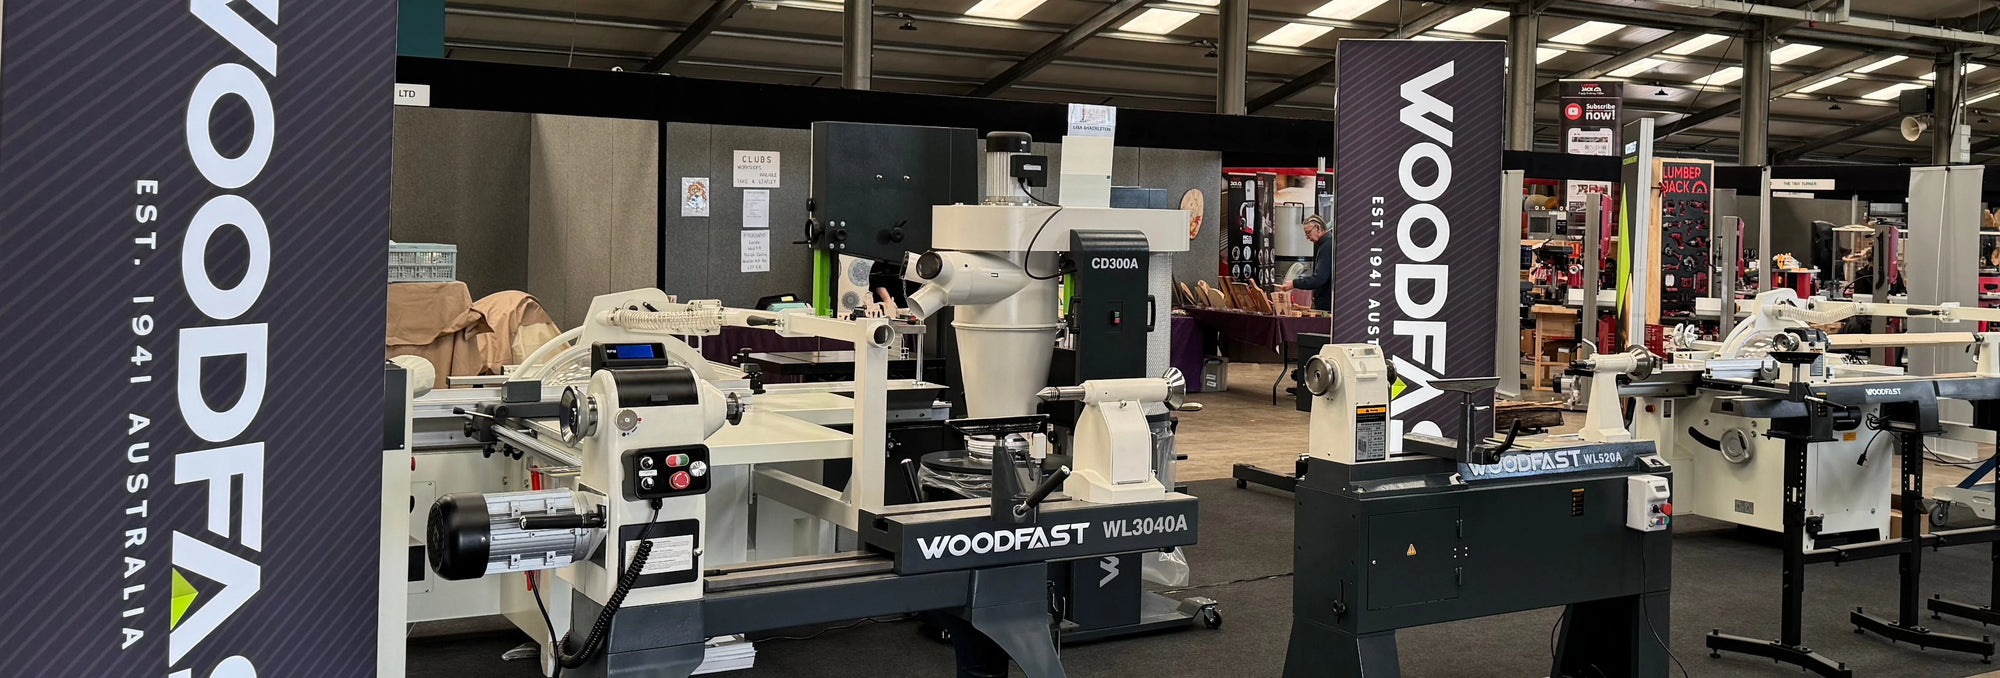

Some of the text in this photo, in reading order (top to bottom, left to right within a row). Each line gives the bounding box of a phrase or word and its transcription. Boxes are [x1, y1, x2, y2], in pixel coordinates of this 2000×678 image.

[398, 89, 416, 98] LTD
[1585, 110, 1616, 120] now!
[742, 155, 772, 163] CLUBS
[1663, 166, 1702, 179] LUMBER
[1664, 180, 1690, 193] JACK
[1371, 196, 1385, 236] EST.
[1091, 257, 1139, 269] CD300A
[1369, 248, 1383, 287] 1941
[1864, 387, 1902, 396] WOODFAST
[121, 179, 159, 650] EST. 1941 AUSTRALIA
[1583, 451, 1623, 465] WL520A
[916, 514, 1188, 560] WOODFAST WL3040A
